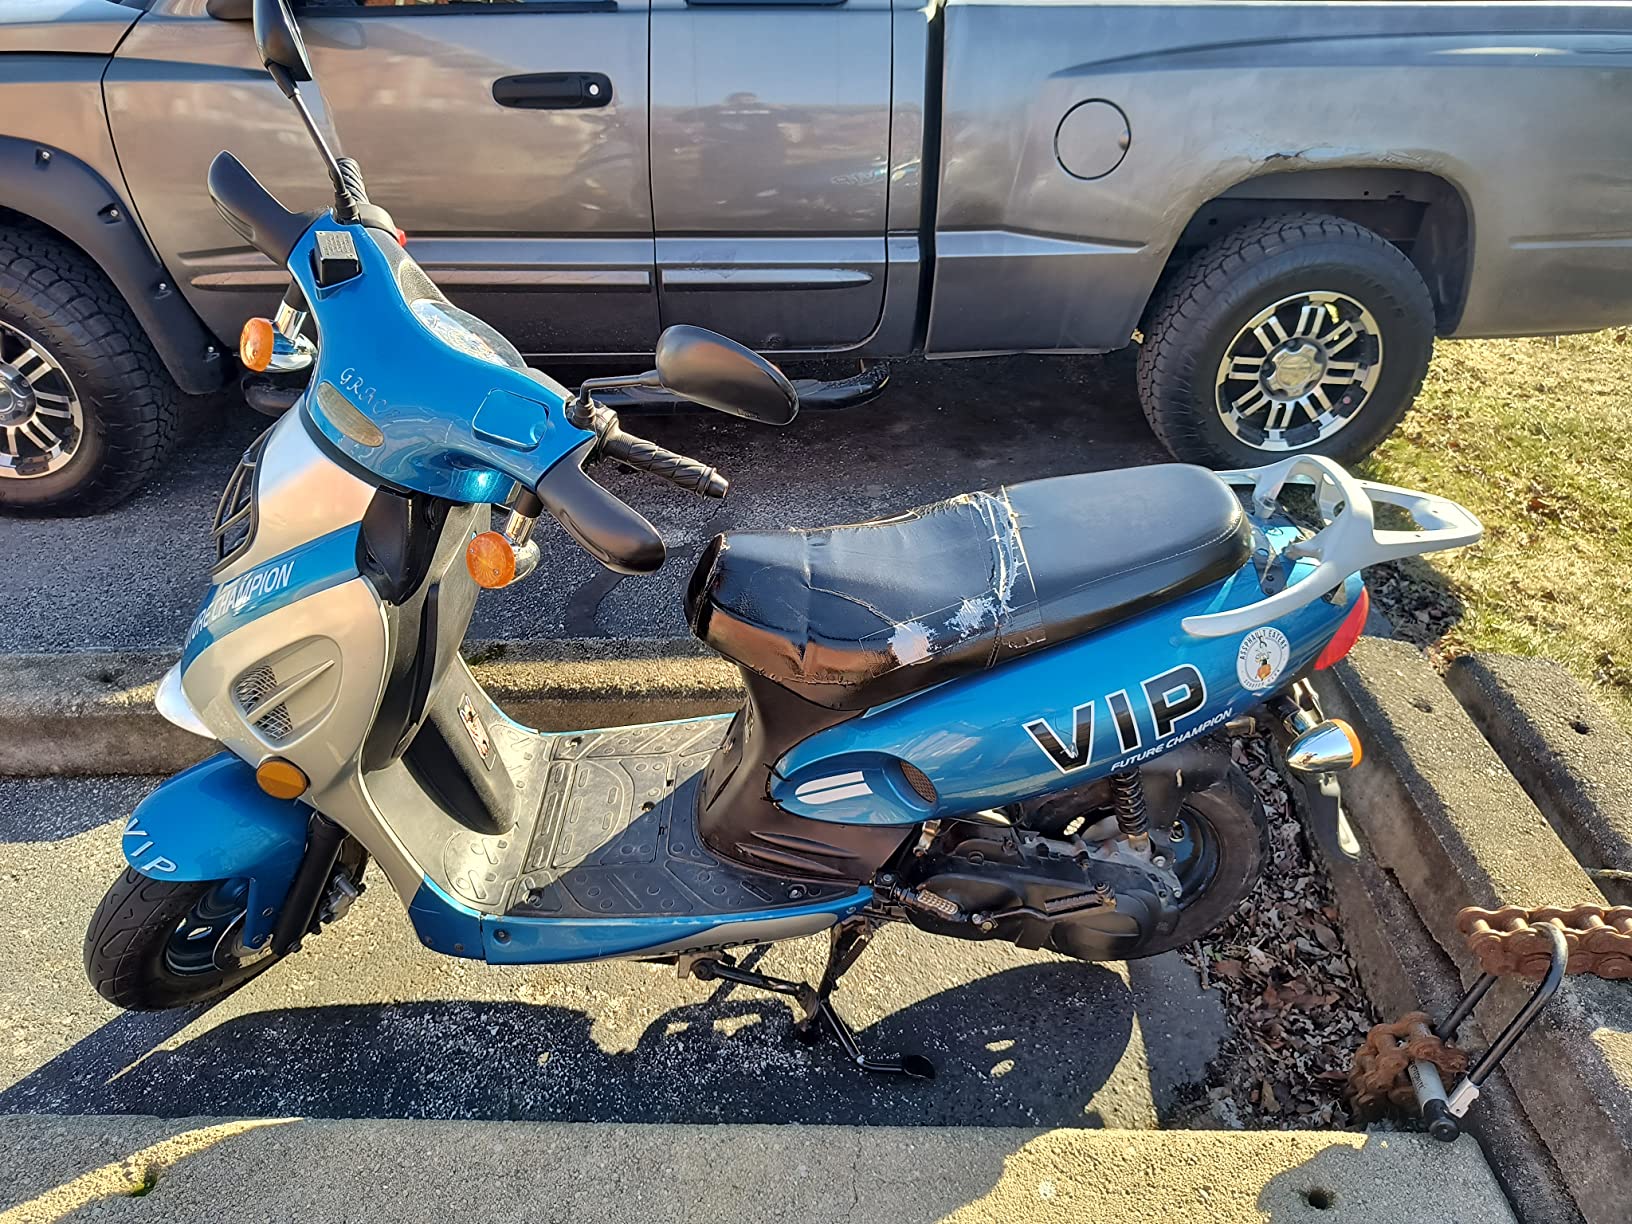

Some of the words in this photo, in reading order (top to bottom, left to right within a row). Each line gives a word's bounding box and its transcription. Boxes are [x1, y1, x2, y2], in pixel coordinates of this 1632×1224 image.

[340, 367, 400, 417] GRAC
[211, 561, 295, 622] CHAMPION
[1268, 629, 1288, 650] EATERS
[1022, 663, 1207, 775] VIP
[1110, 743, 1165, 772] FUTURE
[1165, 707, 1233, 749] CHAMPION
[123, 817, 177, 872] VIP
